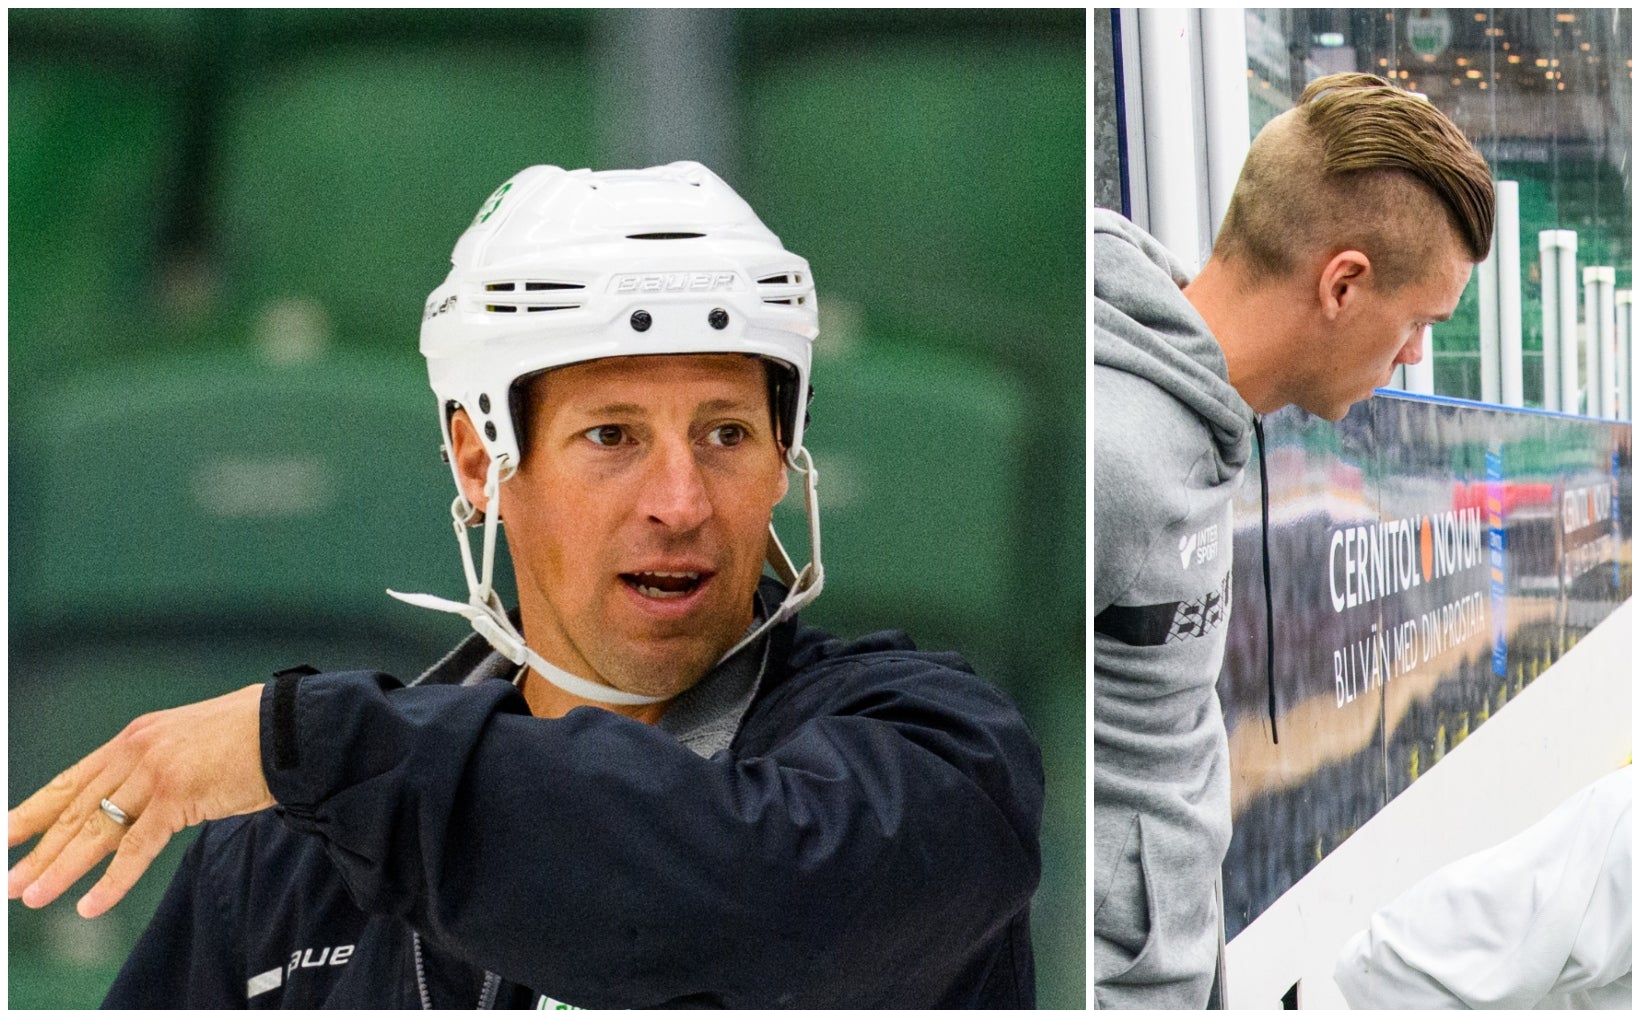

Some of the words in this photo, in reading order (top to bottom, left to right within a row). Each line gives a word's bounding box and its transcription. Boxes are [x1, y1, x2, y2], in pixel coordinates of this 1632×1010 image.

[1433, 506, 1482, 579] NOVUM
[1334, 643, 1357, 709] BLI
[1359, 623, 1391, 695] VÄN
[1394, 620, 1418, 678] MED
[1422, 608, 1442, 663] DIN
[1443, 591, 1485, 652] PROSTATA
